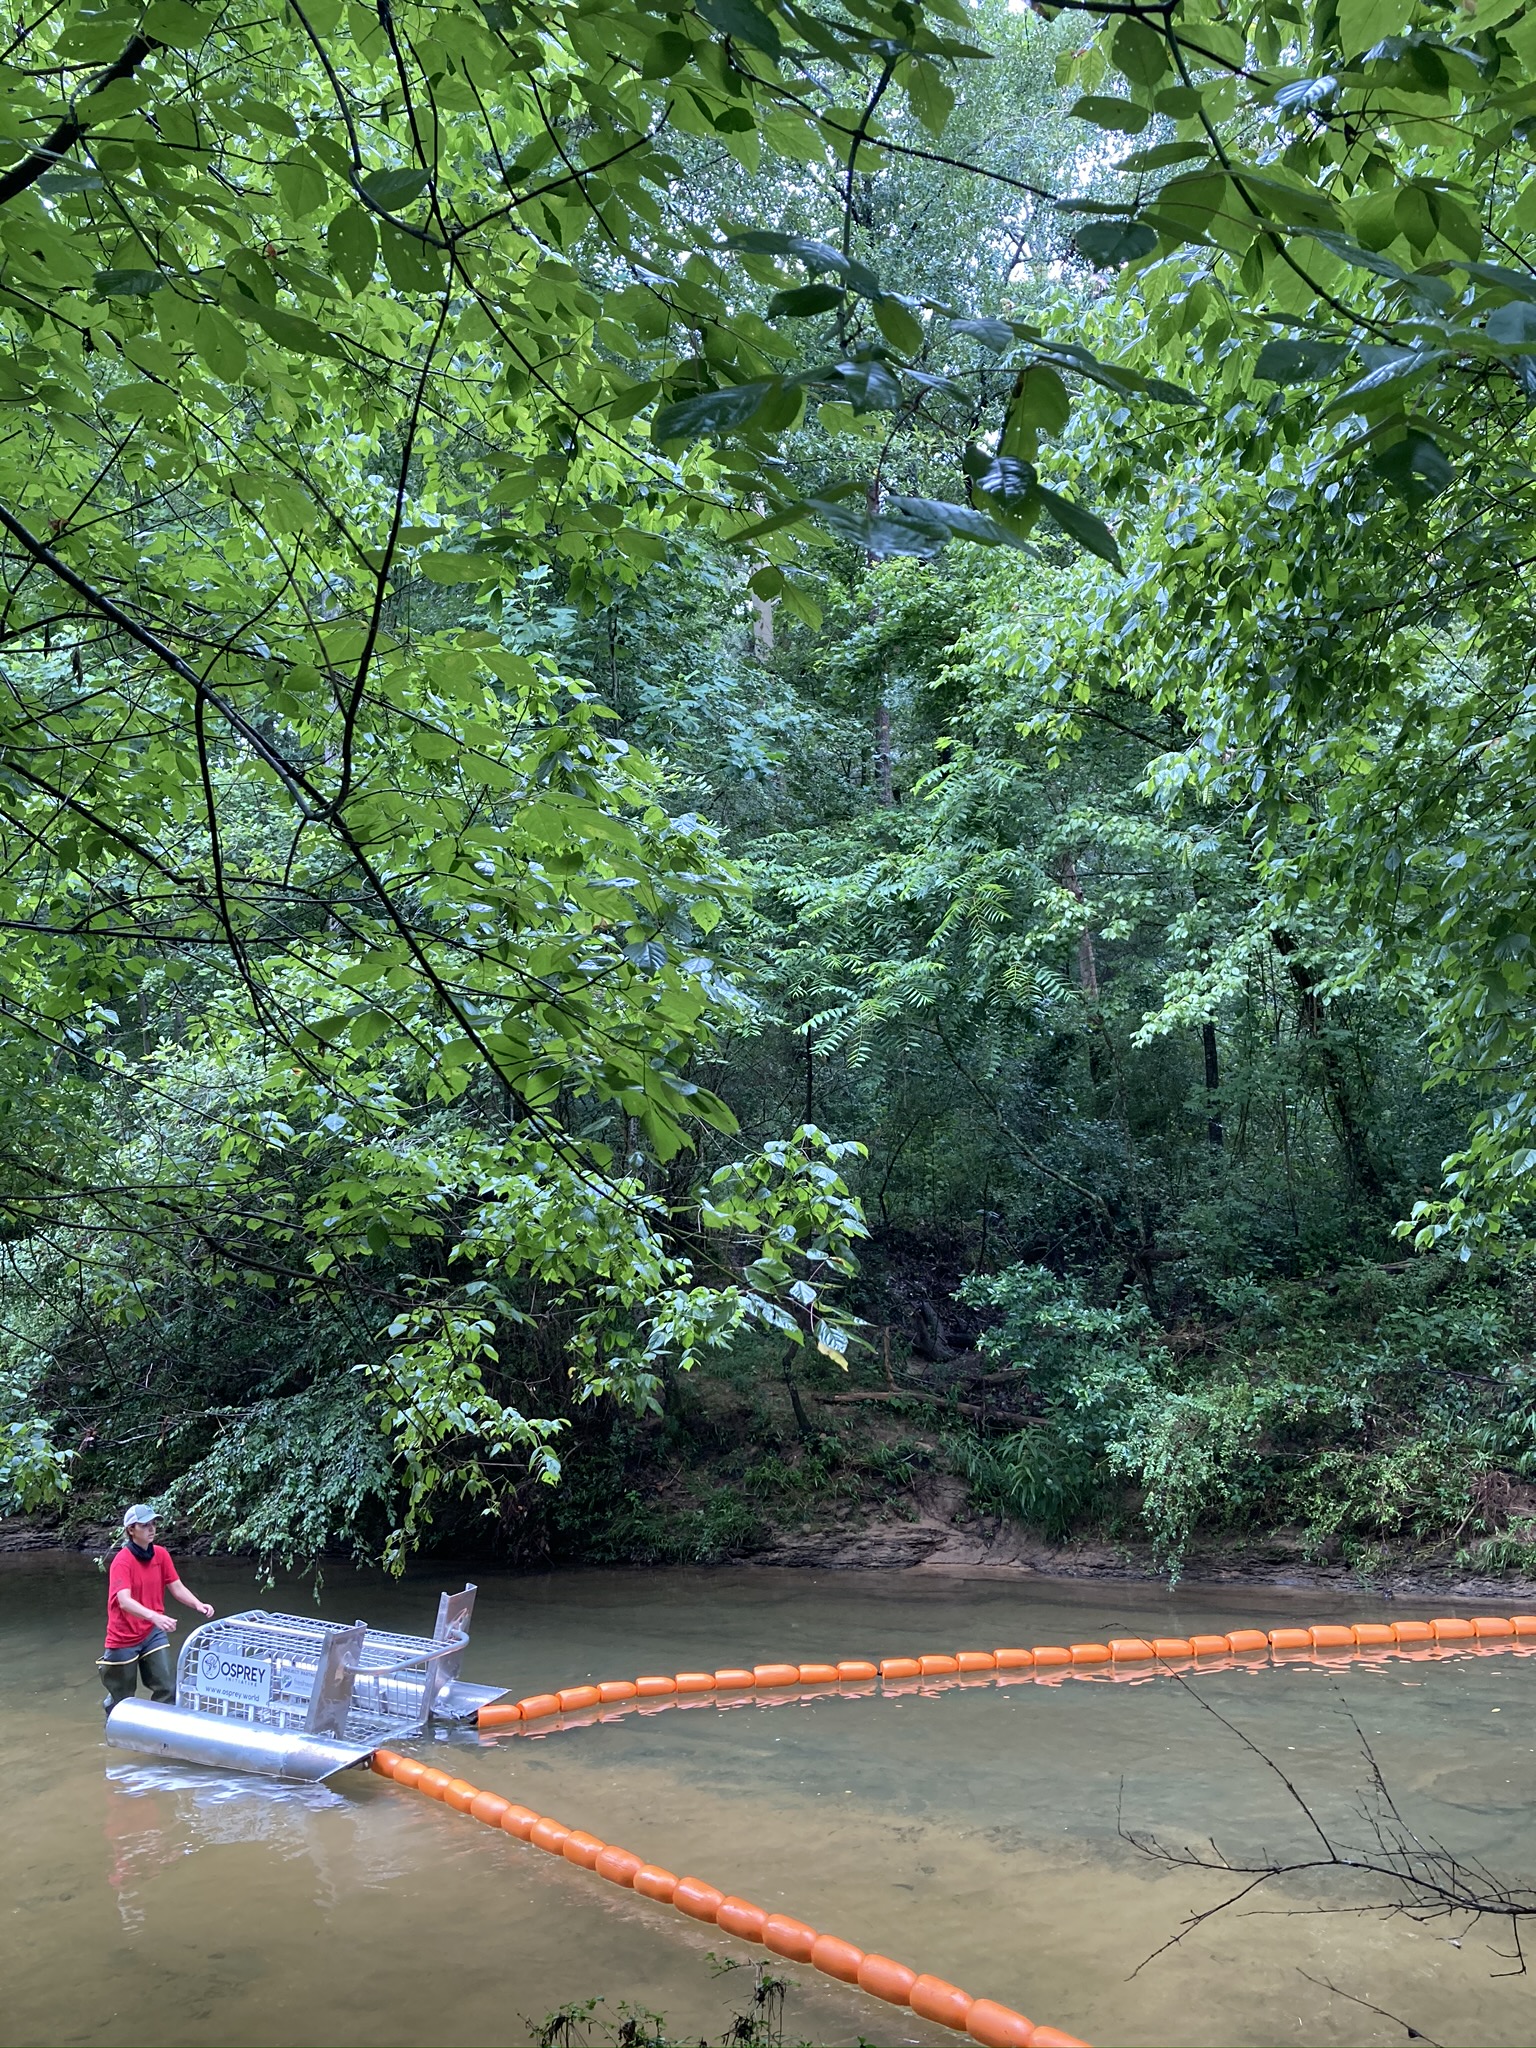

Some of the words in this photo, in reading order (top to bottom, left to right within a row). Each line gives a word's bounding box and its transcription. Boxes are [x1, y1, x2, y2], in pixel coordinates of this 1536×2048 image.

[221, 1662, 266, 1683] OSPREY
[225, 1677, 258, 1687] INITIATIVE
[205, 1686, 260, 1702] www.osprey.world
